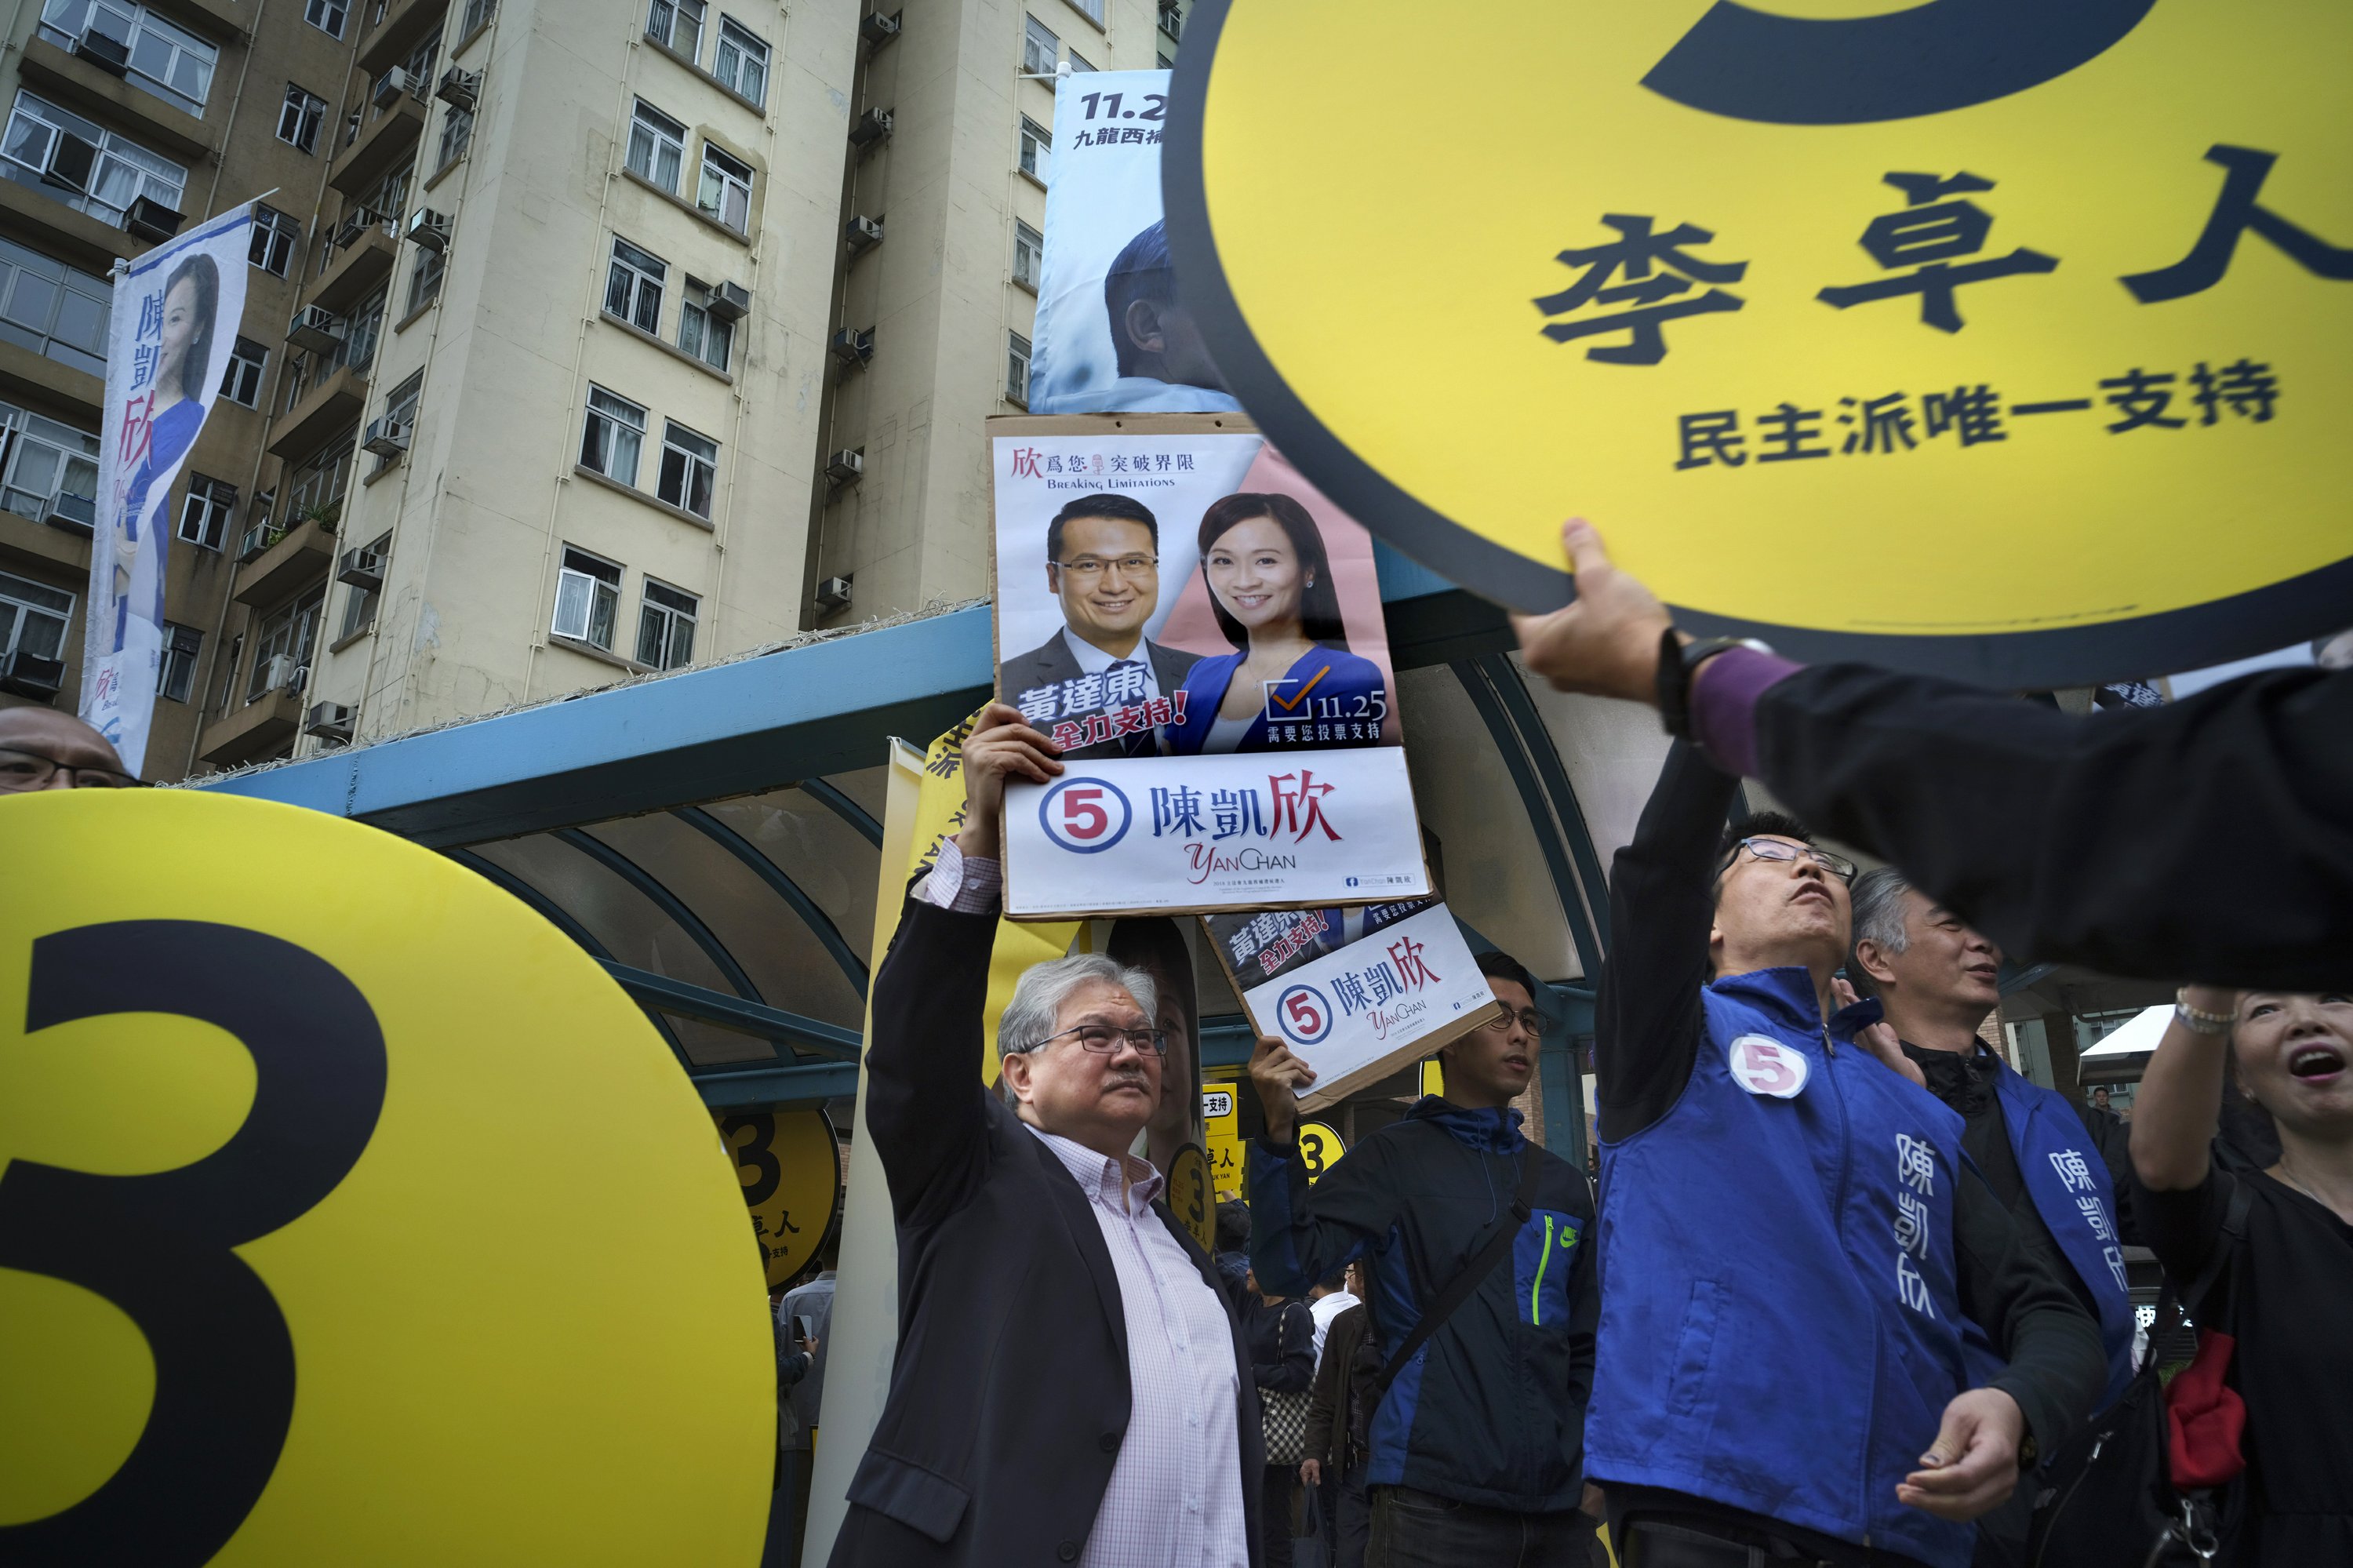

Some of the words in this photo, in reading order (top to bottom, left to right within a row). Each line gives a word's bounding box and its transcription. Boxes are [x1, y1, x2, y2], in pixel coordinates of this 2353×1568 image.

[1530, 143, 2353, 366] 李卓人
[1675, 358, 2279, 472] 民主派唯一支持
[1111, 453, 1195, 472] 突破界限
[1017, 661, 1148, 724] 黃達東
[1318, 690, 1387, 720] 11.25
[1267, 722, 1380, 743] 需要您投票支持
[1064, 789, 1108, 839] 5
[1151, 769, 1344, 844] 陳凱欣
[1330, 936, 1442, 1017] 陳凱欣
[1286, 992, 1321, 1035] 5
[1743, 1046, 1799, 1095] 5
[720, 1112, 781, 1207] 3
[1300, 1133, 1324, 1178] 3
[1187, 1169, 1206, 1224] 3
[0, 919, 388, 1568] 3
